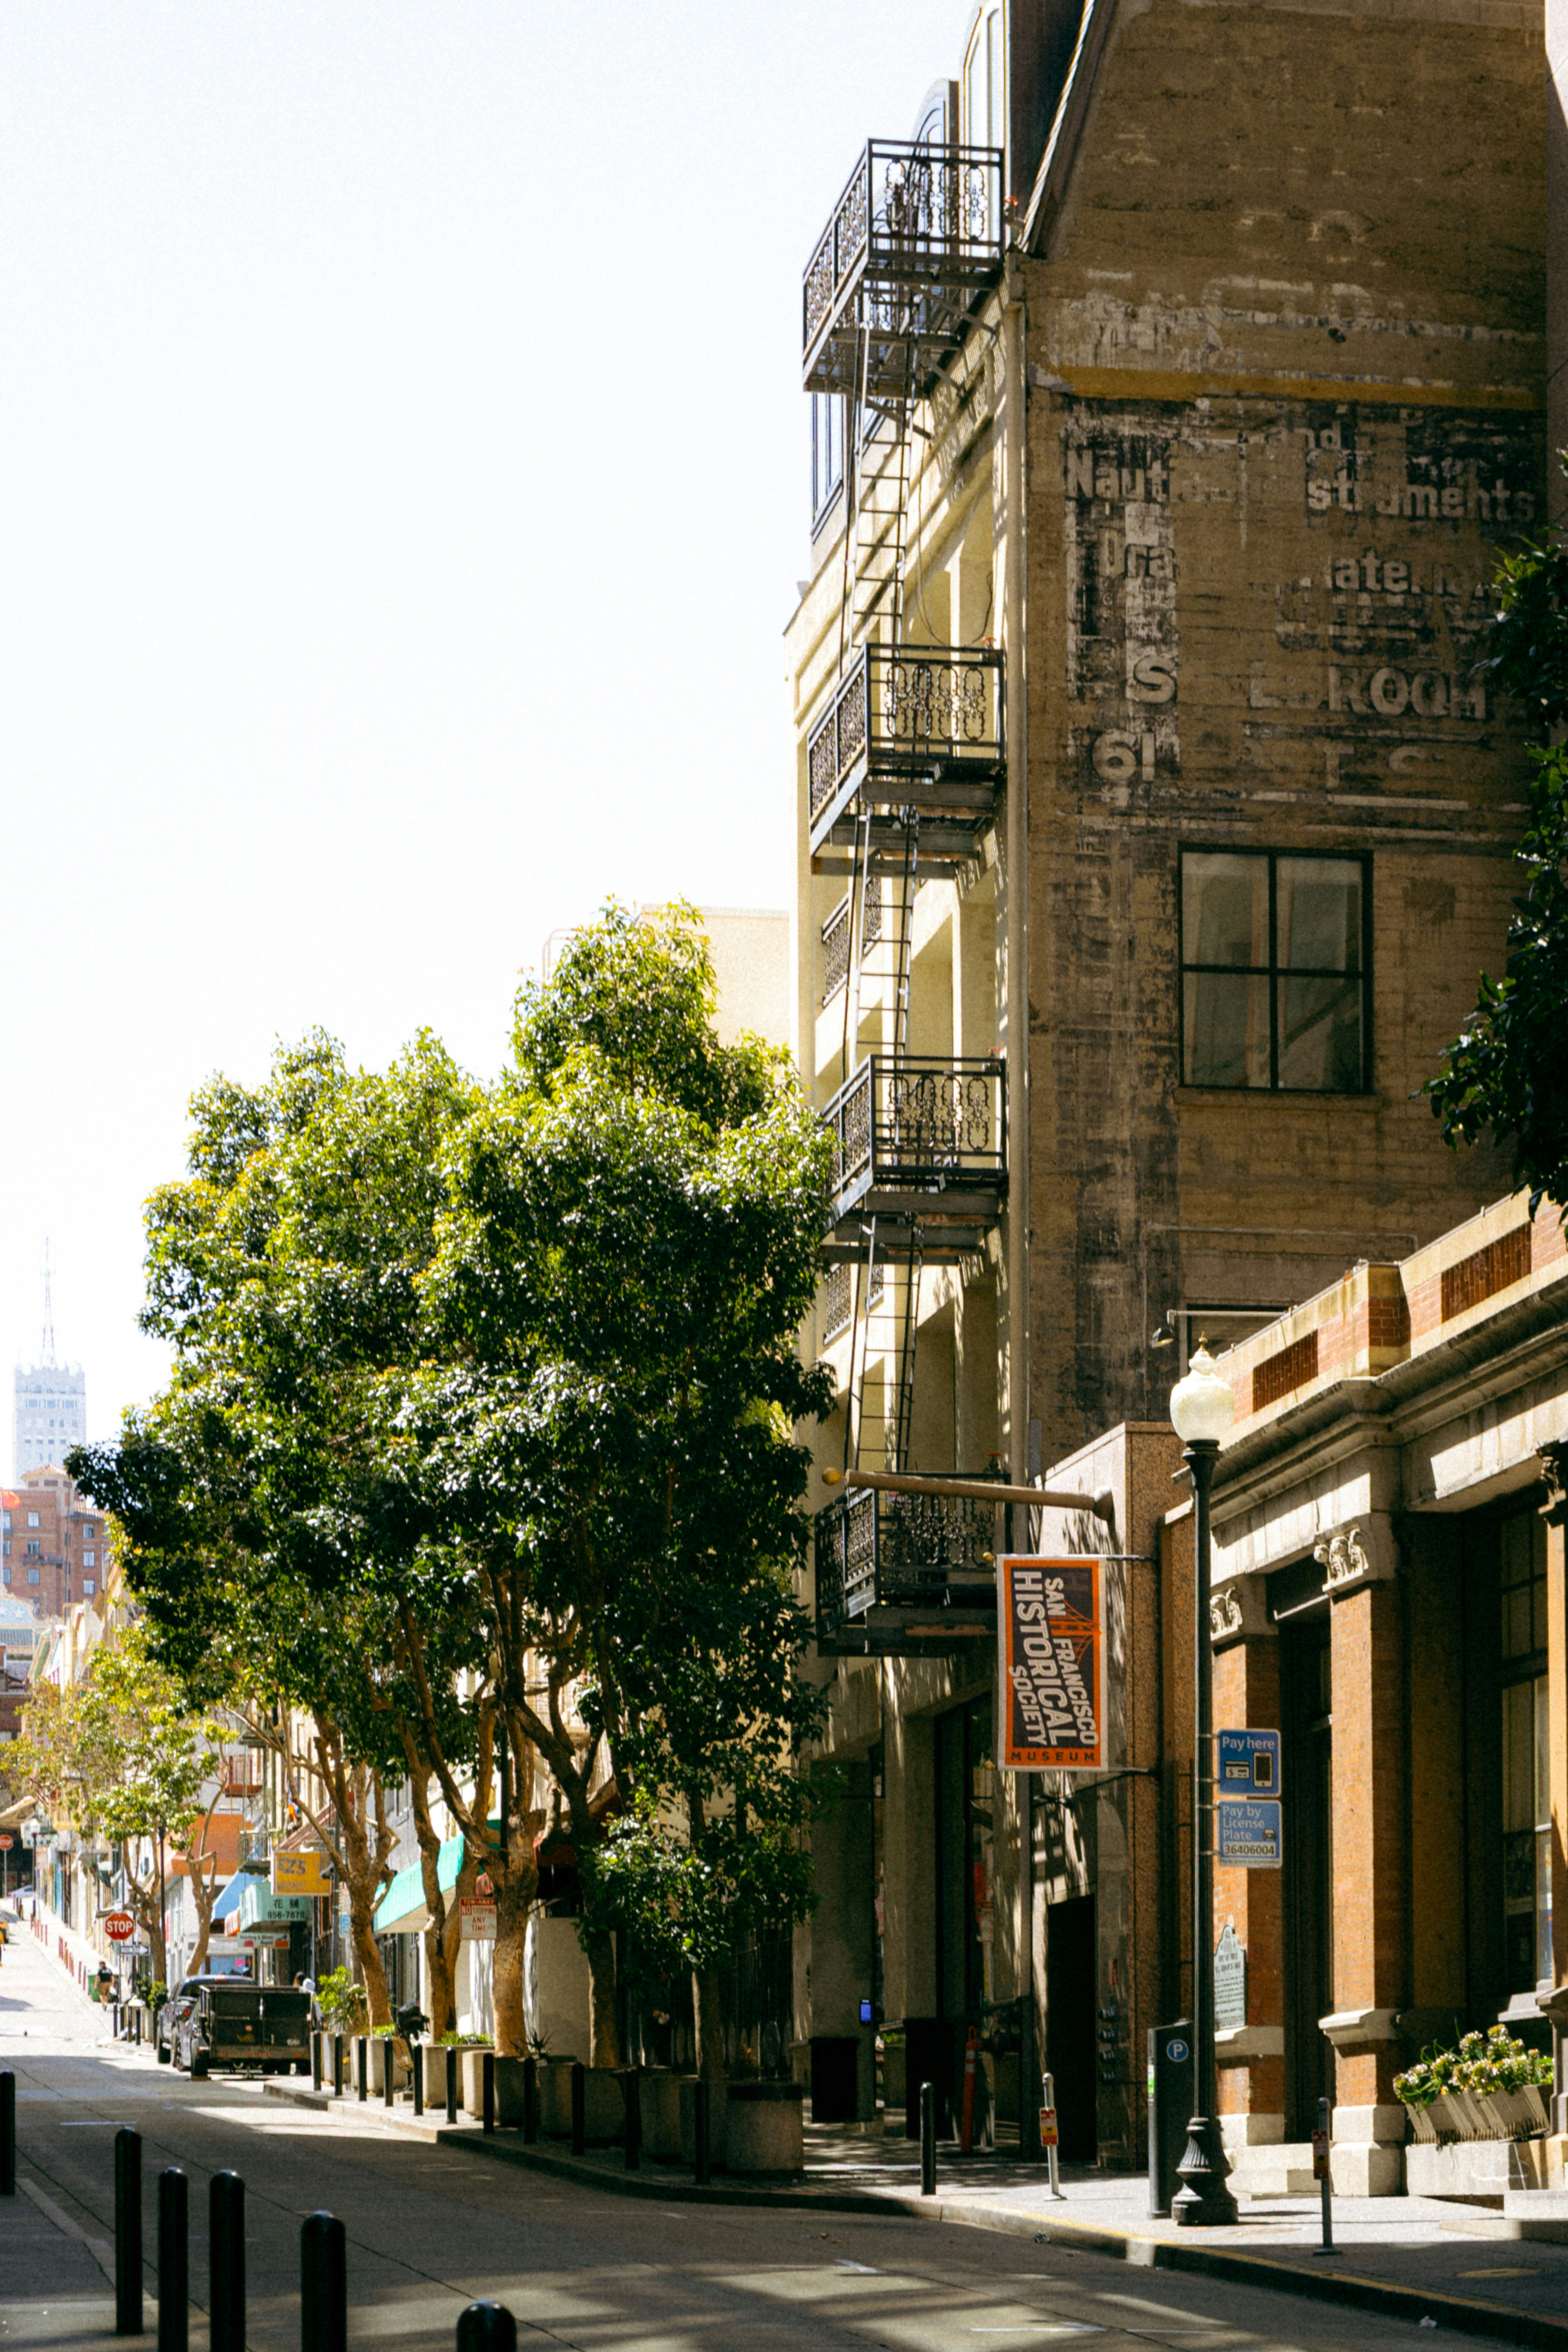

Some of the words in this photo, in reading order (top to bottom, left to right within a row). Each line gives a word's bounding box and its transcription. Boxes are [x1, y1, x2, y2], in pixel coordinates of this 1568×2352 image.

[1045, 1577, 1066, 1616] SAN
[1013, 1571, 1077, 1746] HISTORICAL
[1053, 1638, 1098, 1745] FRANCISCO
[1009, 1665, 1047, 1746] SOCIETY
[1222, 1736, 1245, 1751] Pay
[1247, 1736, 1275, 1749] here
[1011, 1751, 1095, 1762] MUSEUM
[1223, 1806, 1243, 1819] Pay
[1247, 1805, 1261, 1819] by
[1223, 1817, 1265, 1828] License
[1223, 1830, 1252, 1840] Plate
[1225, 1844, 1275, 1855] 36406004
[267, 1910, 305, 1919] 956-7878
[461, 1905, 471, 1915] NO
[107, 1921, 132, 1933] STOP
